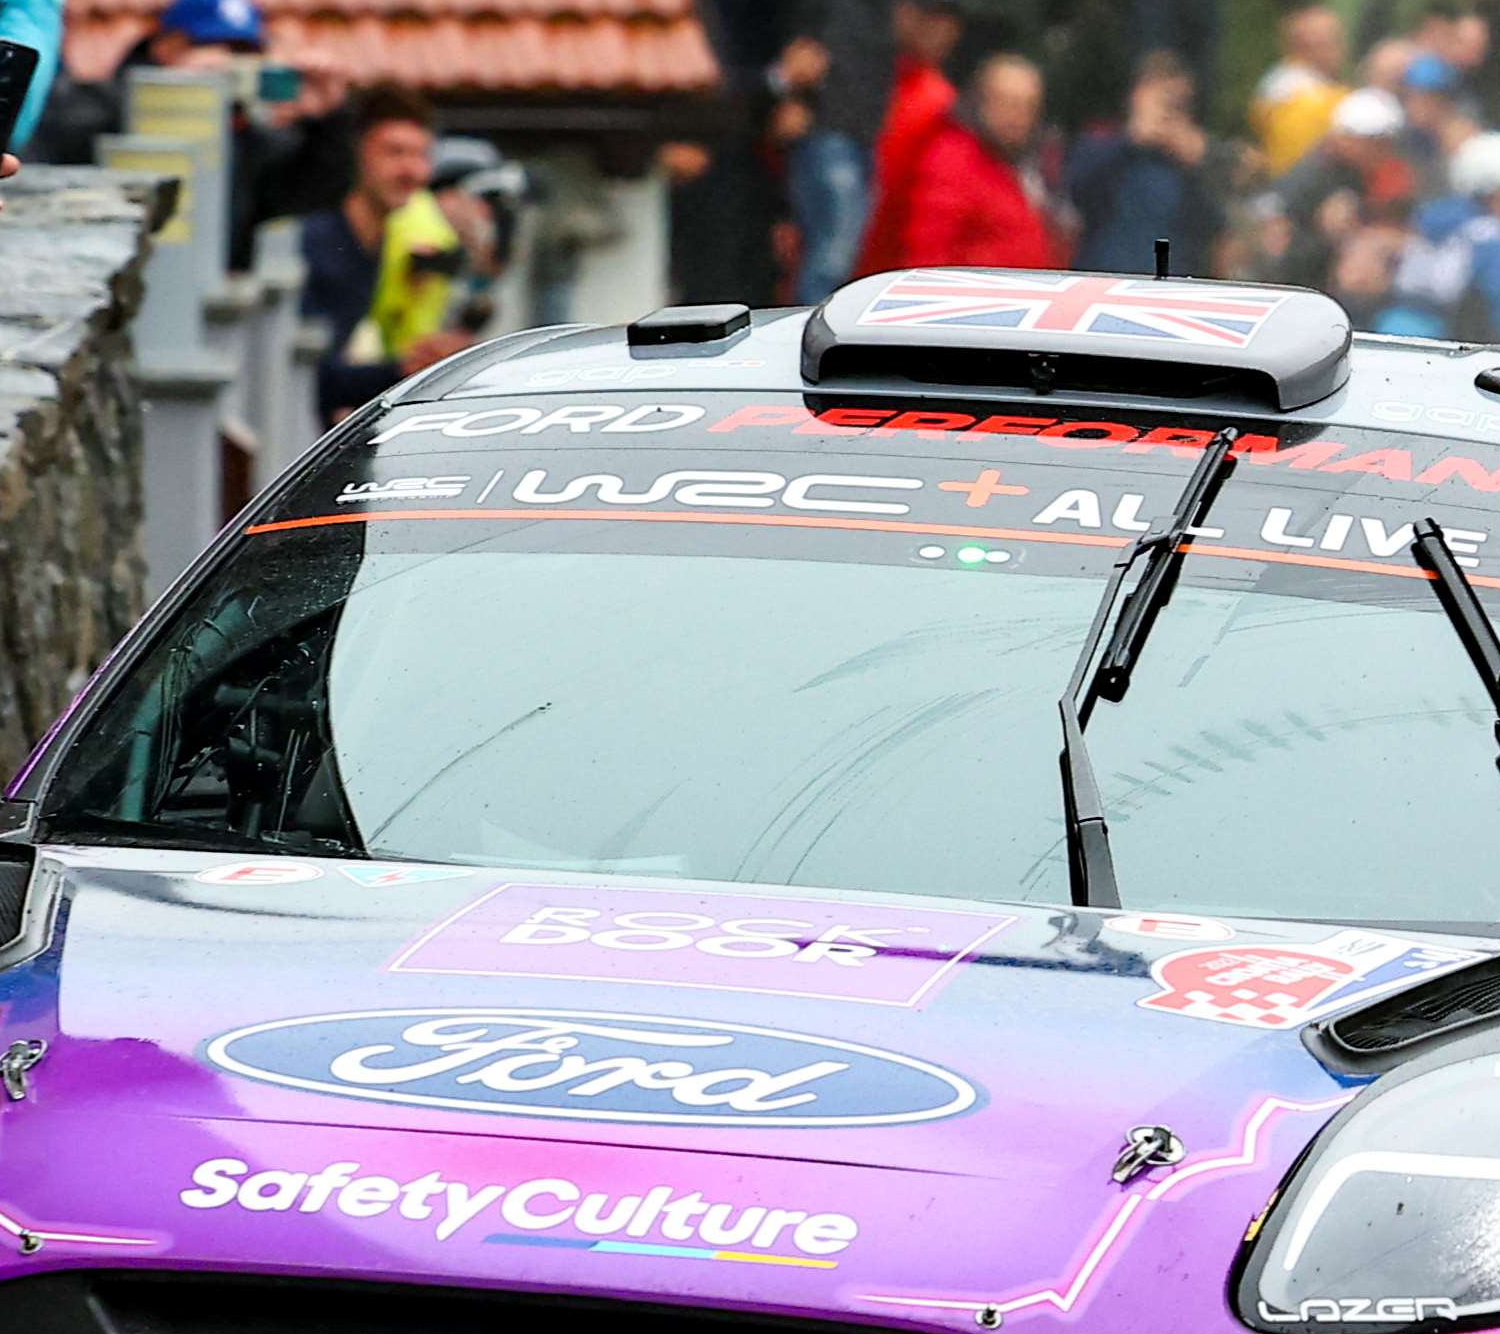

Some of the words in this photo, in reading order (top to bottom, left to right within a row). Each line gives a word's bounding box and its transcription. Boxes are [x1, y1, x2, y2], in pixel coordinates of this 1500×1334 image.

[366, 405, 706, 446] FORD
[500, 923, 879, 969] DOOR
[528, 907, 904, 946] ROCK
[330, 1016, 851, 1113] Ford
[179, 1159, 860, 1255] SafetyCulture
[1257, 1297, 1459, 1323] LAZER
